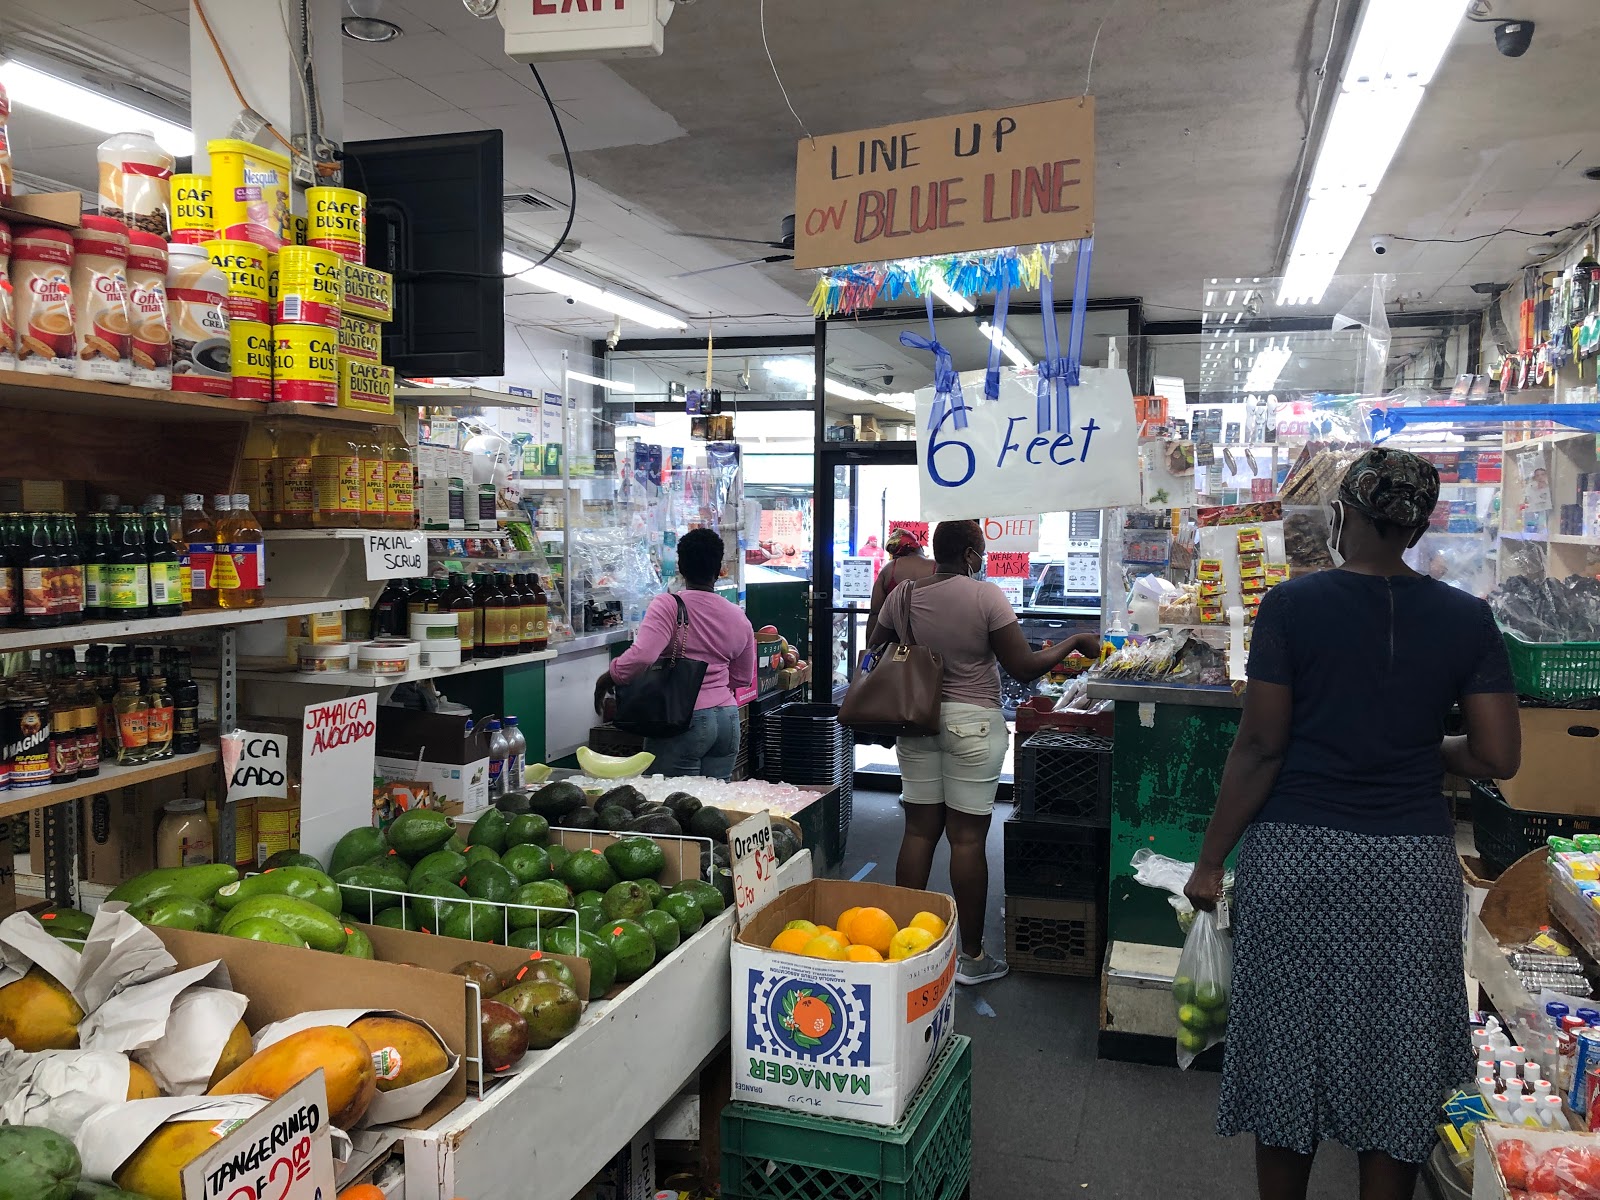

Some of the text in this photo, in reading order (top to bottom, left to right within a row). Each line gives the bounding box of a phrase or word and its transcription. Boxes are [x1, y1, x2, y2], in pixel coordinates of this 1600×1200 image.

[831, 117, 1016, 181] LINE UP
[244, 169, 278, 188] Nesquik
[177, 188, 213, 202] CAF
[805, 158, 1081, 244] ON BLUE LINE
[177, 204, 213, 219] BUST
[316, 200, 360, 216] CAFE
[316, 216, 360, 232] BUSTE
[211, 255, 247, 269] AFE
[315, 262, 341, 279] CAF
[222, 270, 266, 290] TELO
[345, 265, 375, 286] CAFE
[30, 277, 69, 295] Coff
[345, 280, 388, 303] BUSTELO
[340, 317, 366, 335] CAFE
[310, 340, 337, 355] CAF
[339, 330, 378, 352] BUSTELO
[351, 362, 378, 379] CAFE
[350, 376, 390, 396] BUSTELO
[927, 405, 1101, 488] 6 Feet
[912, 530, 927, 542] SK
[985, 517, 1036, 541] 6 FEET
[370, 536, 412, 553] FACIAL
[383, 554, 422, 570] SCRUB
[990, 552, 1023, 561] WEAR A
[996, 561, 1027, 575] MASK
[306, 698, 367, 730] JAMAICA
[310, 720, 375, 756] AVOCADO
[735, 826, 770, 860] Orange
[736, 874, 745, 908] 3
[749, 1057, 871, 1096] MANAGER
[735, 1082, 763, 1094] ORANGES
[787, 1094, 822, 1107] オレンジ
